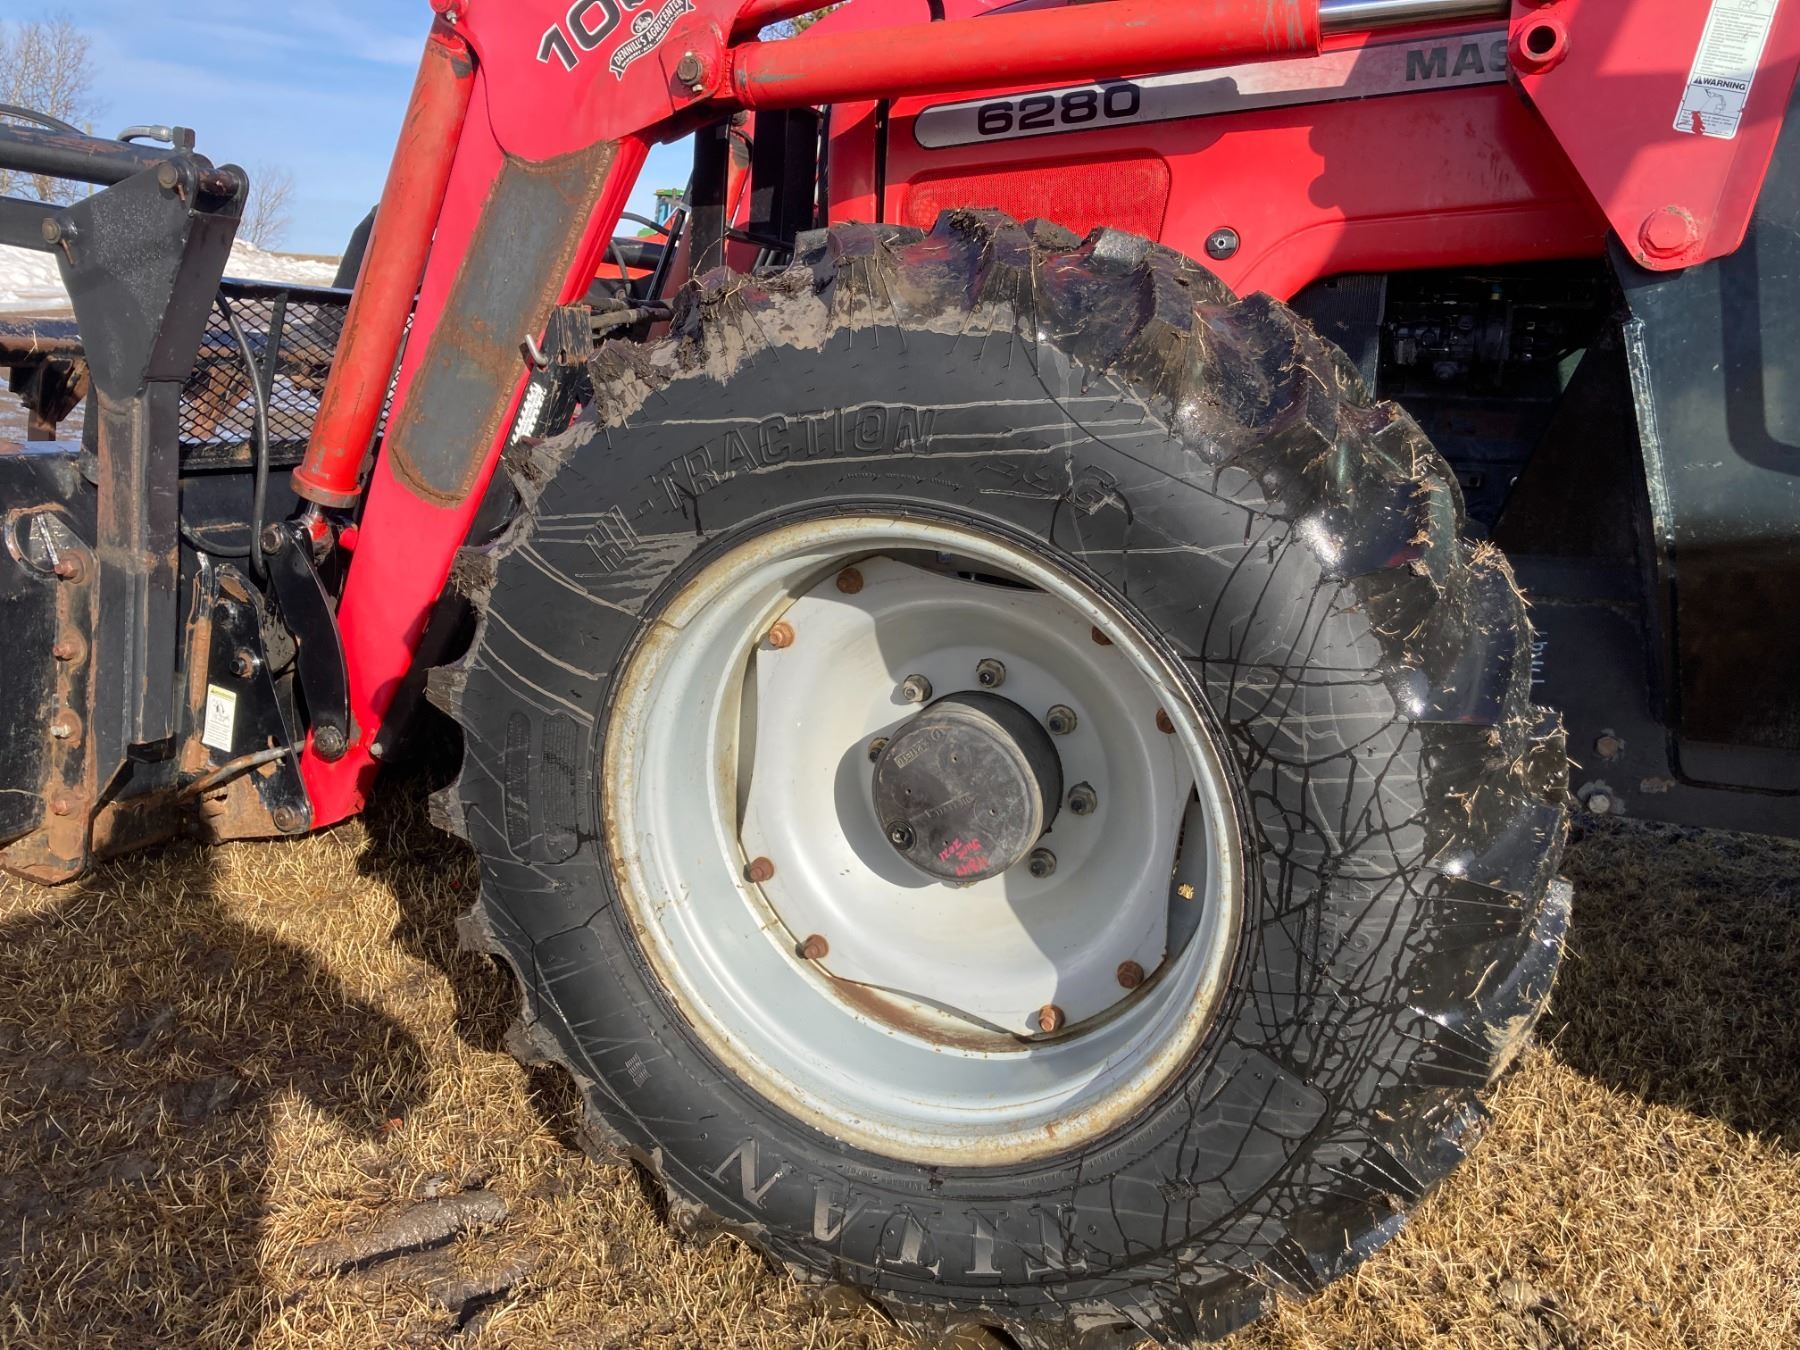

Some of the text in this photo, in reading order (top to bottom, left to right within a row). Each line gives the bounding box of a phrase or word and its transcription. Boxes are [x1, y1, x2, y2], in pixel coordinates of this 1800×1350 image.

[614, 36, 648, 66] DENNILL'S
[1702, 77, 1746, 91] WARNING
[977, 83, 1140, 136] 6280
[697, 1135, 1090, 1282] TITAN
